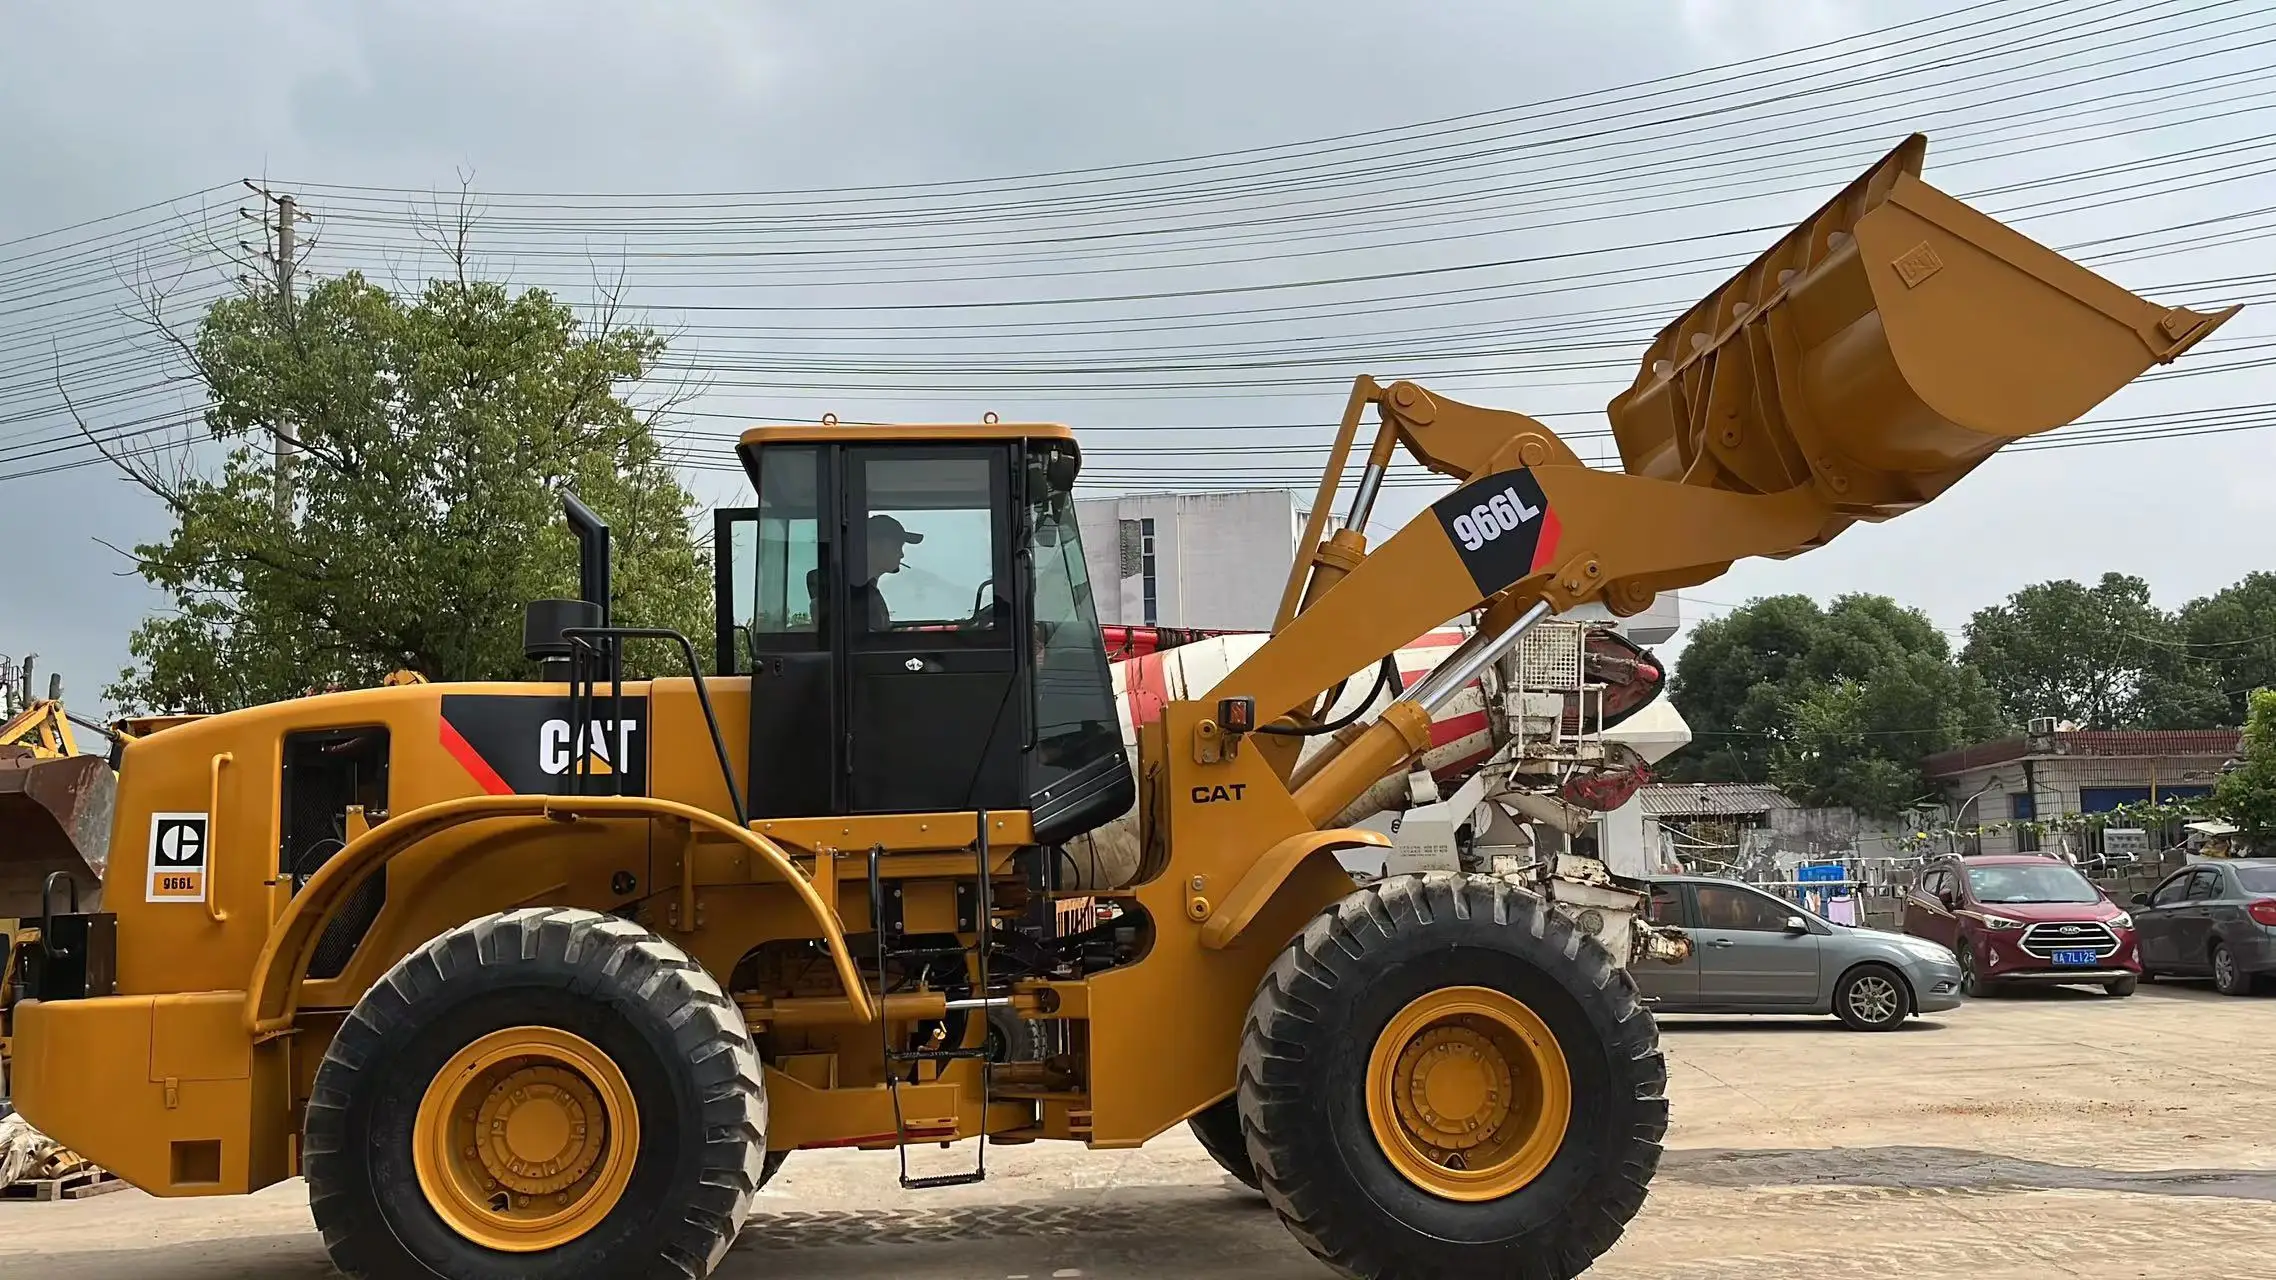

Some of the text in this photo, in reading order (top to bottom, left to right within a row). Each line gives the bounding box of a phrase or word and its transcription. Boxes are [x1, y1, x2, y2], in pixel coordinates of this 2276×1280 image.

[1453, 487, 1540, 551] 966L
[540, 719, 636, 775] CAT
[1192, 784, 1246, 803] CAT
[164, 877, 194, 889] 966L
